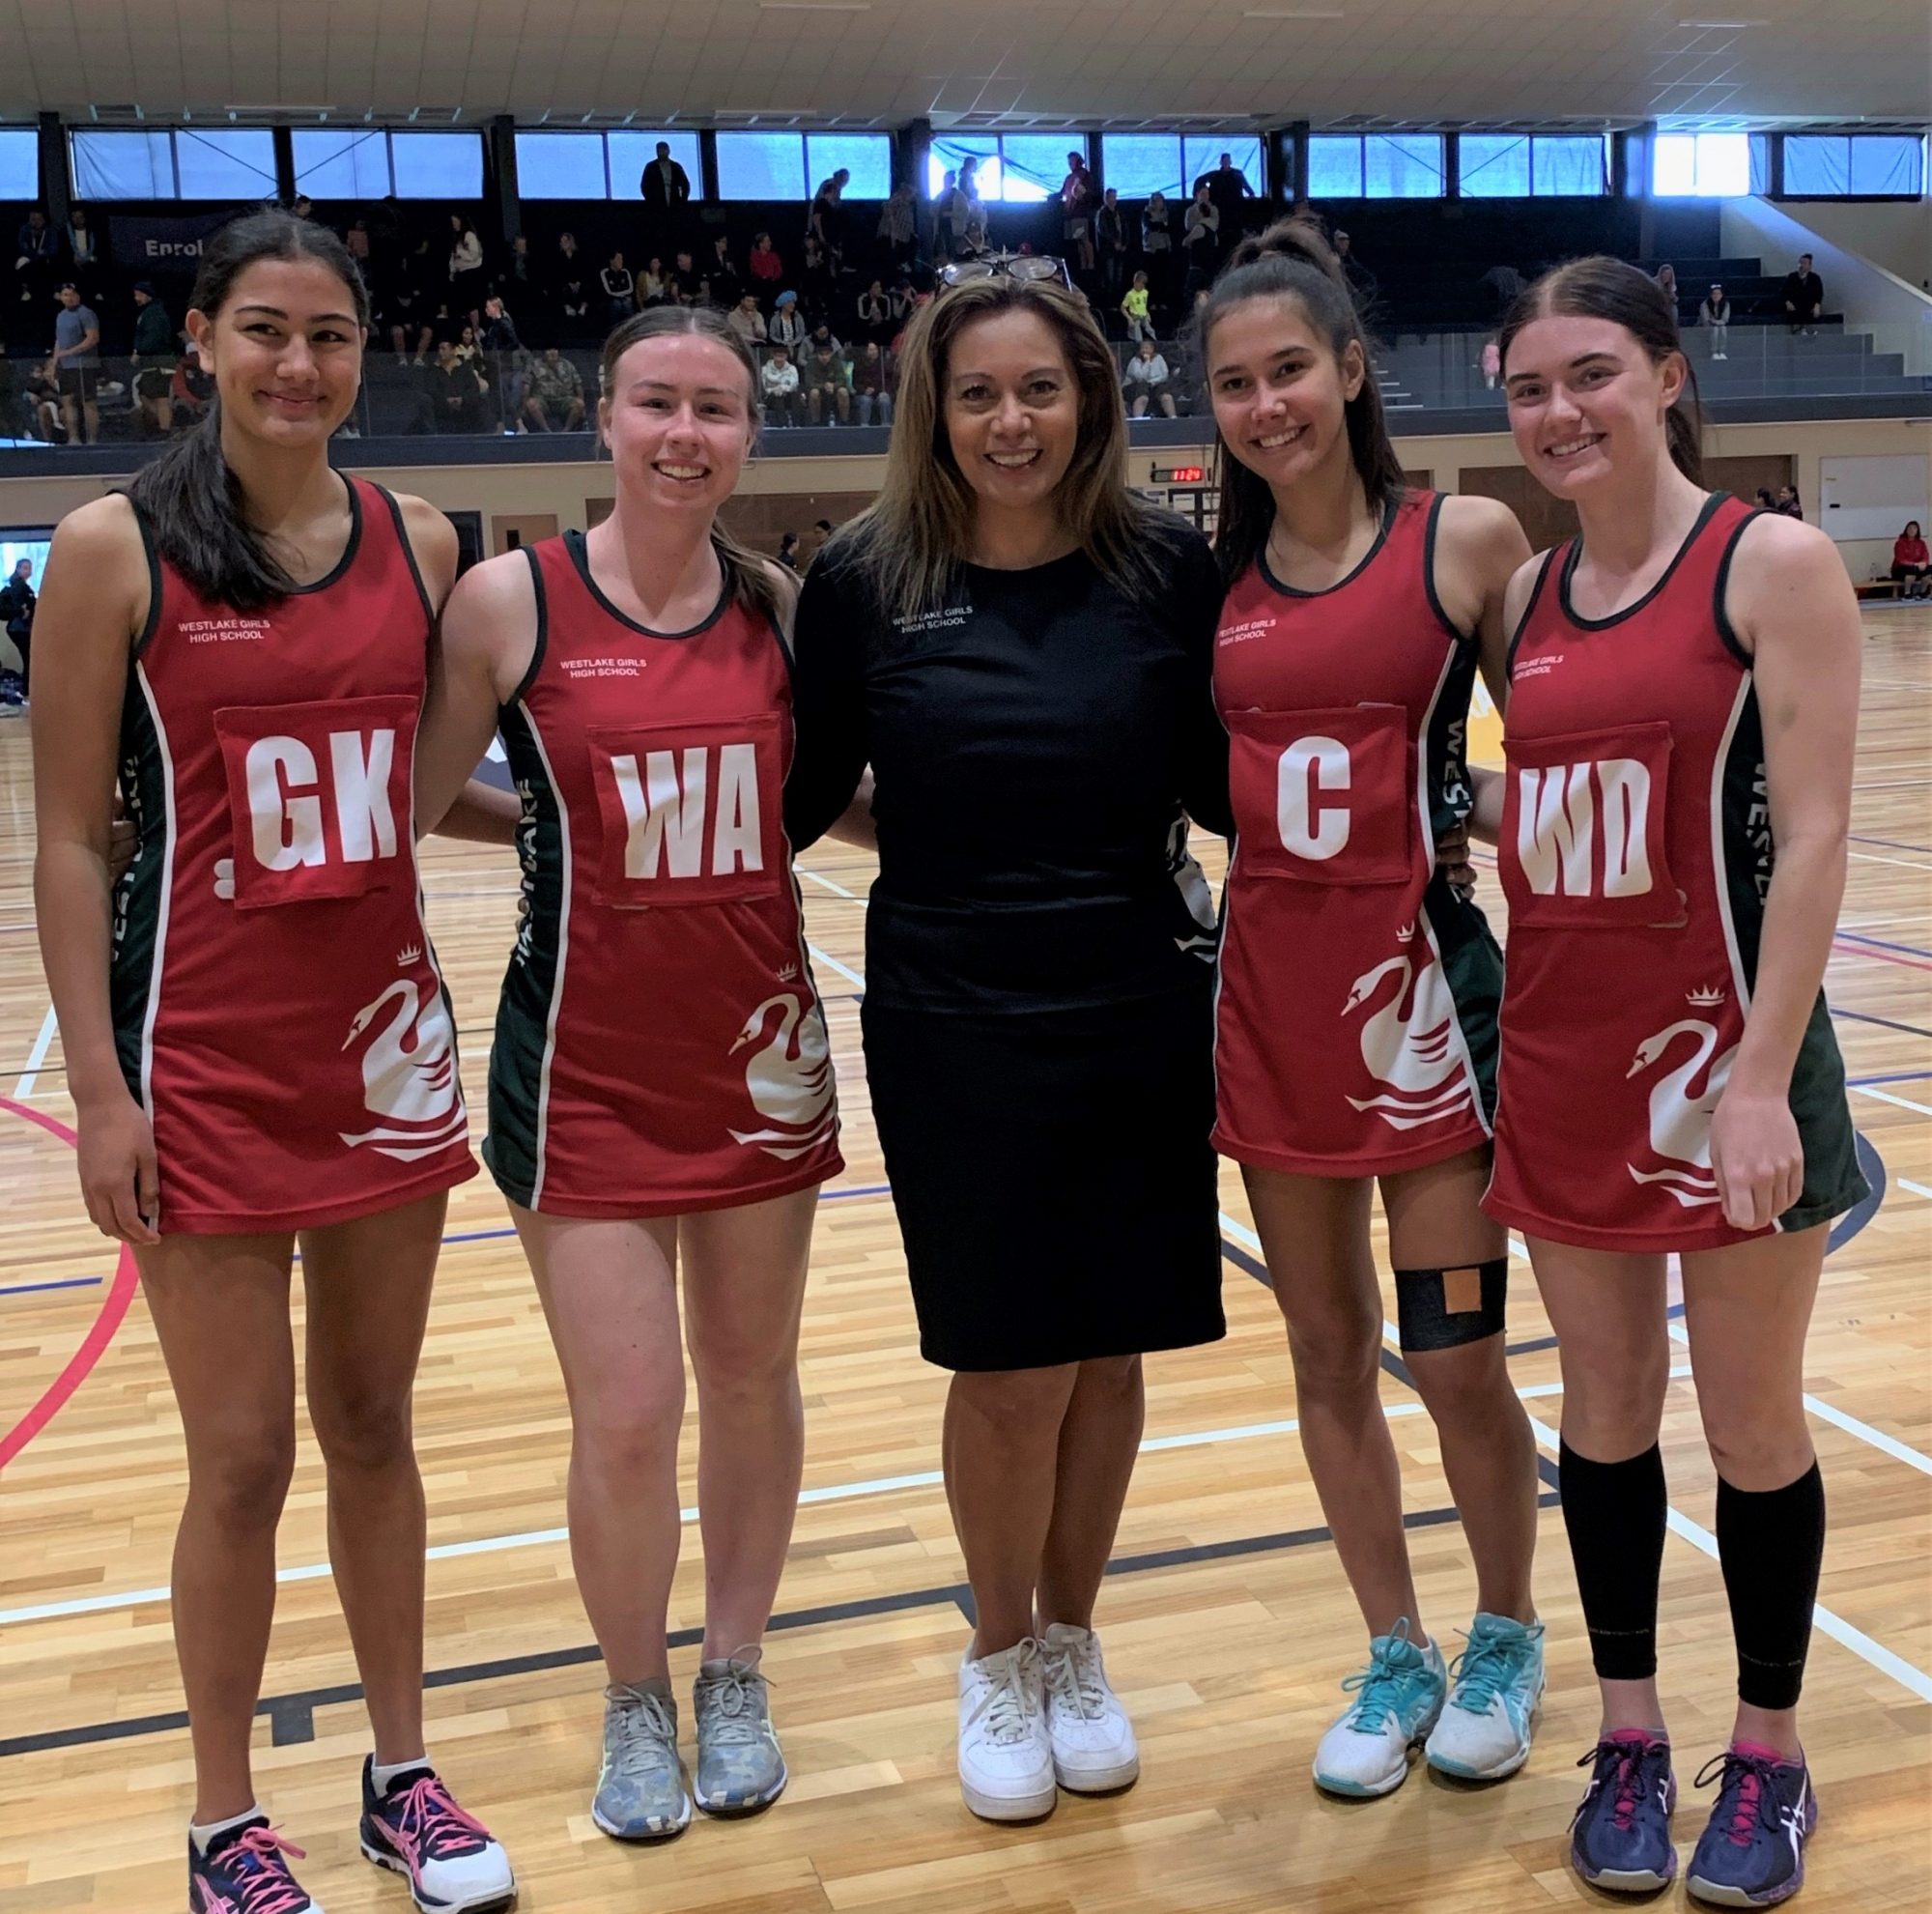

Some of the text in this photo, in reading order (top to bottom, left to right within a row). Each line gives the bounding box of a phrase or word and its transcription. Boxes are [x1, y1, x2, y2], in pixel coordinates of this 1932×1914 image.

[145, 240, 204, 256] Enrol
[893, 605, 974, 626] WETLAKE GIRLS
[178, 619, 270, 633] WESTLAKE GIRLS
[926, 616, 966, 630] SCHOOL
[1250, 618, 1276, 629] GIRLS
[189, 630, 265, 643] HIGH SCHOOL
[1235, 629, 1267, 643] SCHOOL
[560, 658, 647, 670] WESTLAKE GIRLS
[570, 668, 640, 678] HIGH SCHOOL
[245, 728, 398, 871] GK
[1277, 735, 1351, 861] C
[610, 743, 765, 879] WA
[1517, 757, 1654, 899] WD
